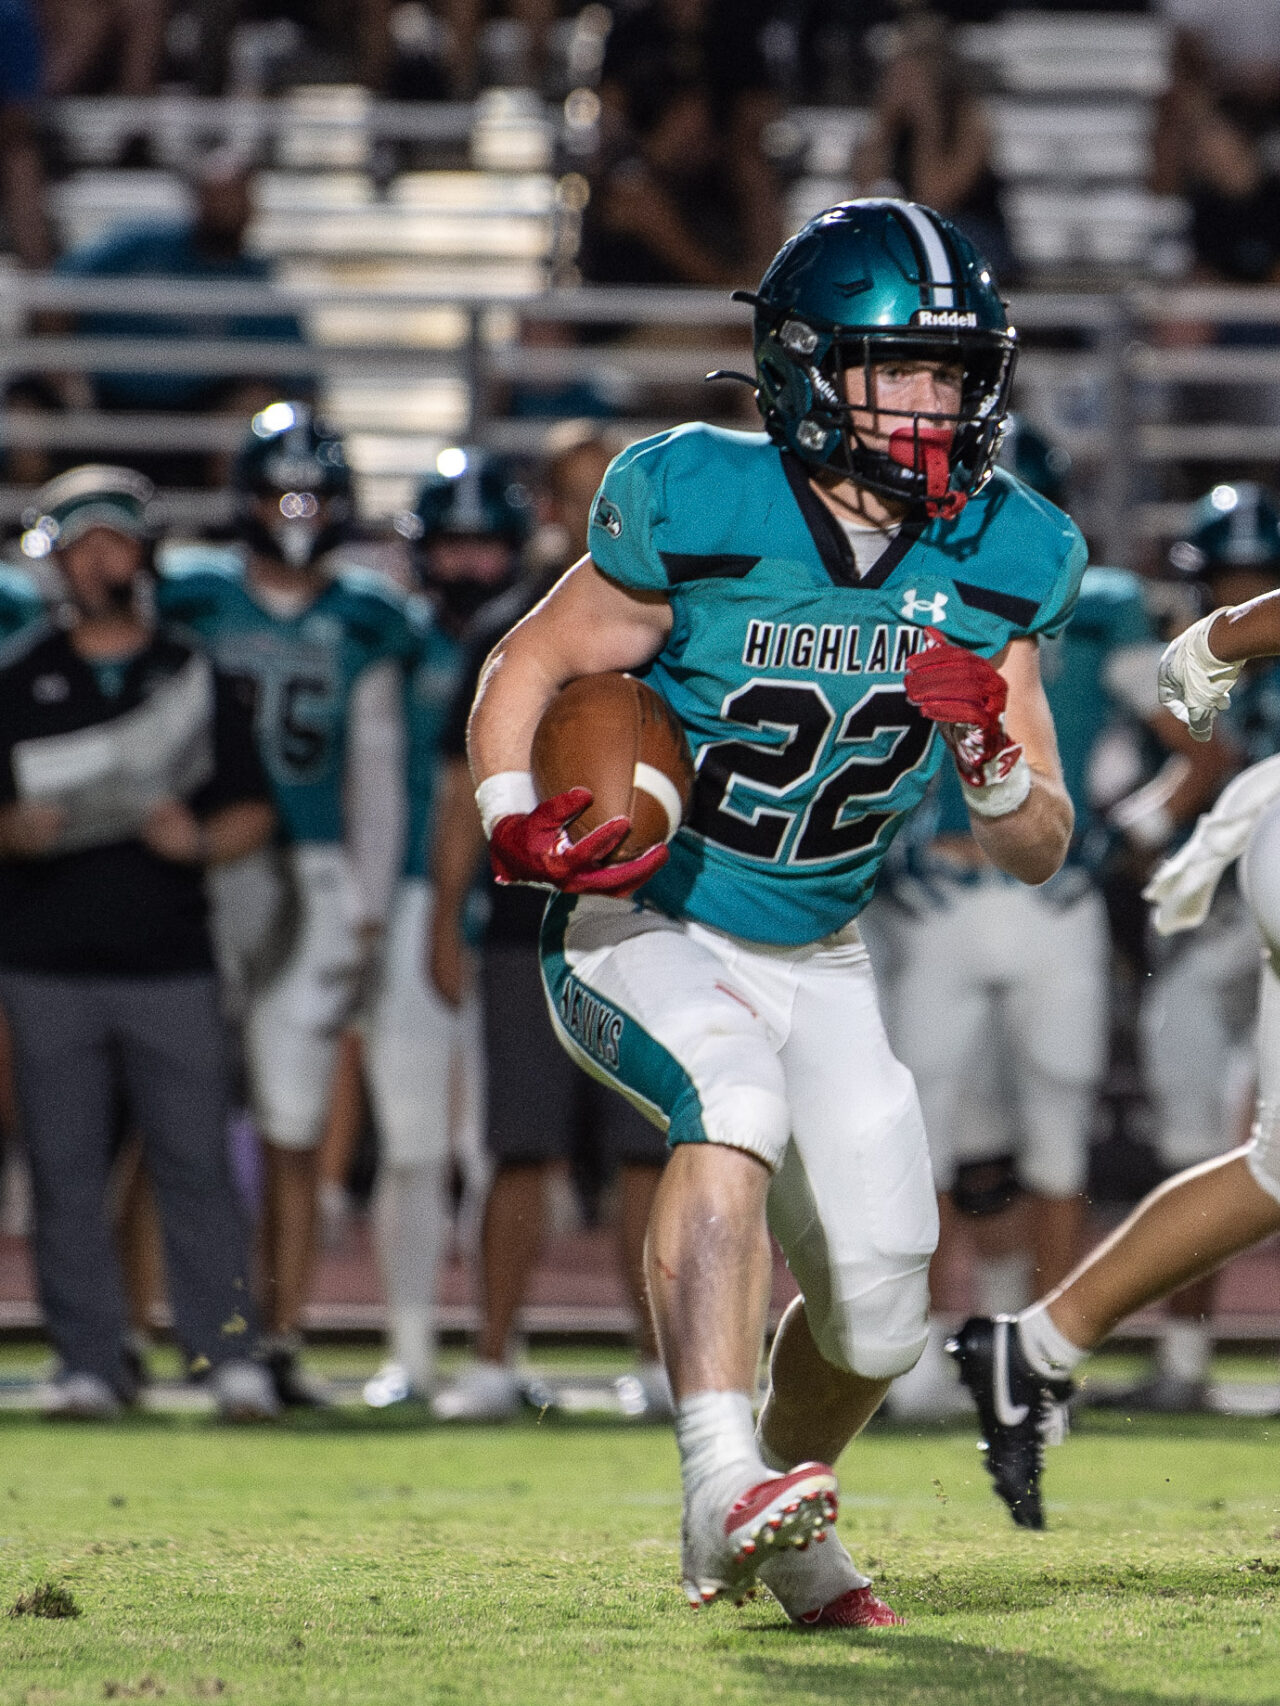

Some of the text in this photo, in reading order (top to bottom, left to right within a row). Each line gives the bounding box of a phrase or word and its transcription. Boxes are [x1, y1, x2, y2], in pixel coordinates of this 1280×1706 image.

[918, 310, 978, 327] Riddell
[742, 618, 924, 675] HIGHLAN
[681, 677, 938, 866] 22
